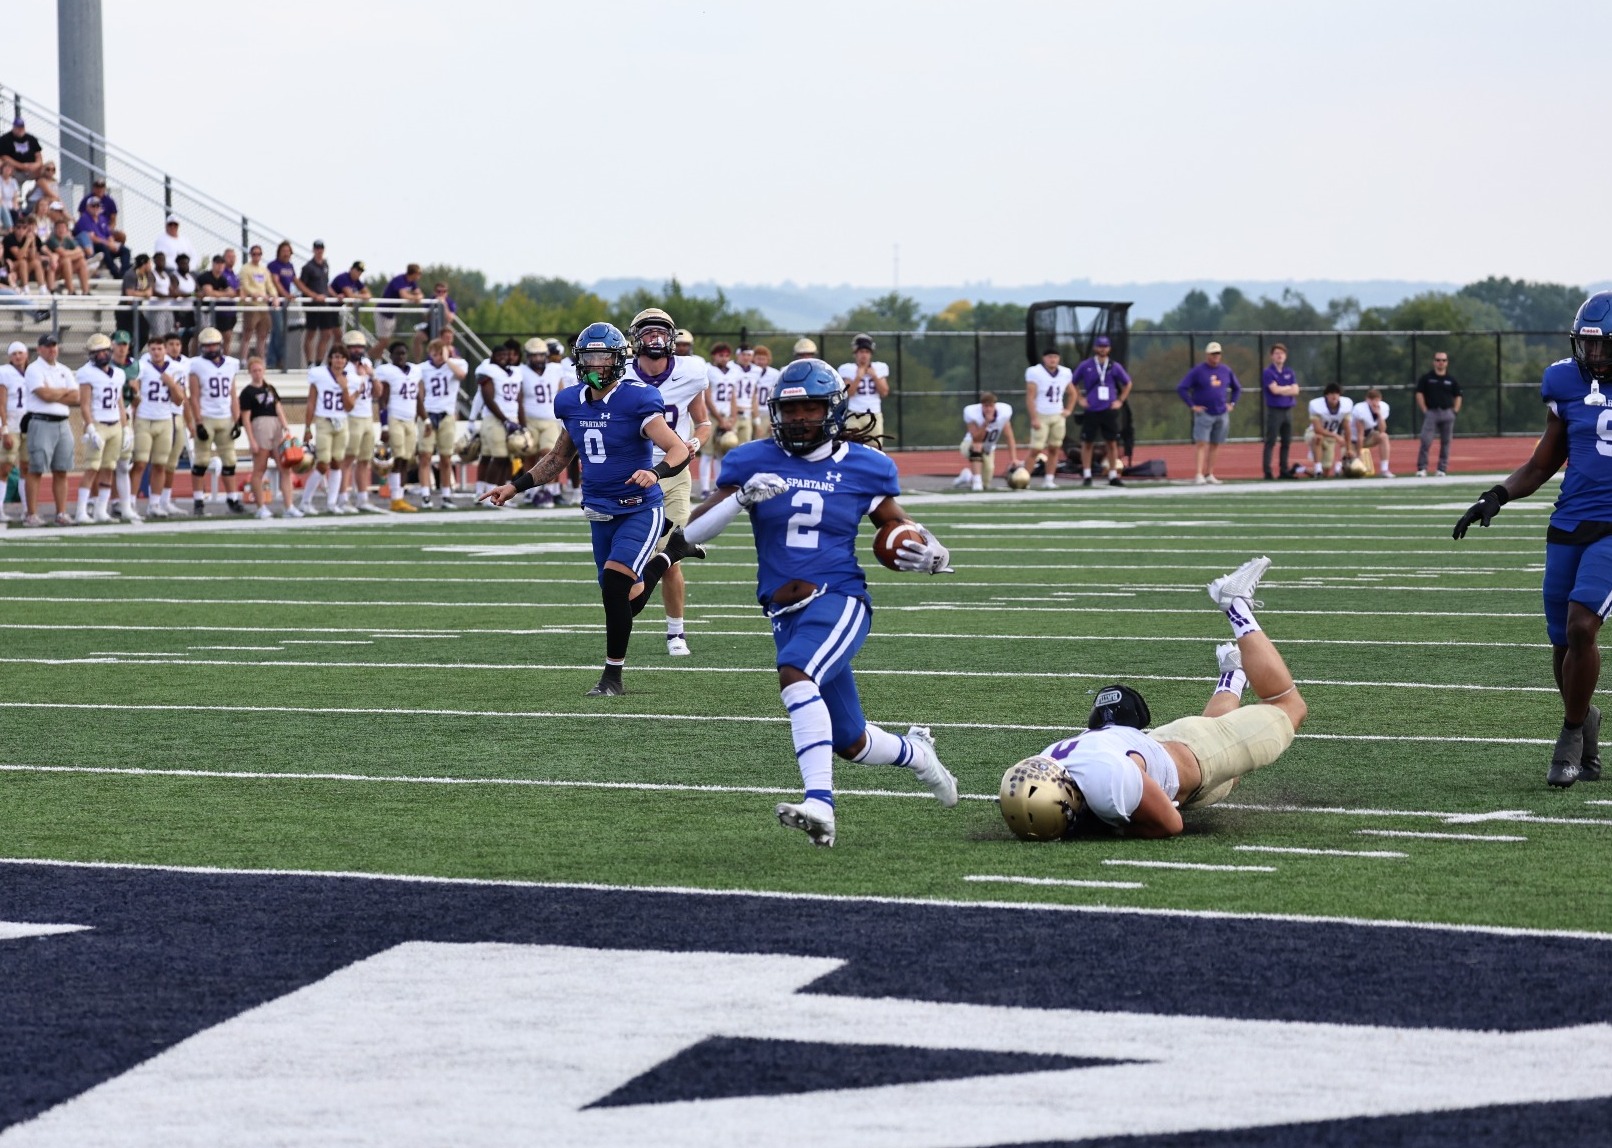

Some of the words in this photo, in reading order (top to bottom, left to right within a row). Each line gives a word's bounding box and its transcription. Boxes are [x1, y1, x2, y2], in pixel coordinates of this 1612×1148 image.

[149, 381, 170, 402] 23
[209, 377, 230, 398] 96
[431, 377, 449, 397] 21
[534, 383, 553, 403] 91
[737, 381, 752, 400] 14
[1046, 385, 1060, 403] 41
[16, 387, 24, 409] 1
[102, 387, 118, 409] 21
[579, 420, 607, 428] SPARTANS
[583, 428, 608, 465] 0
[786, 477, 835, 493] SPARTANS
[785, 489, 824, 549] 2
